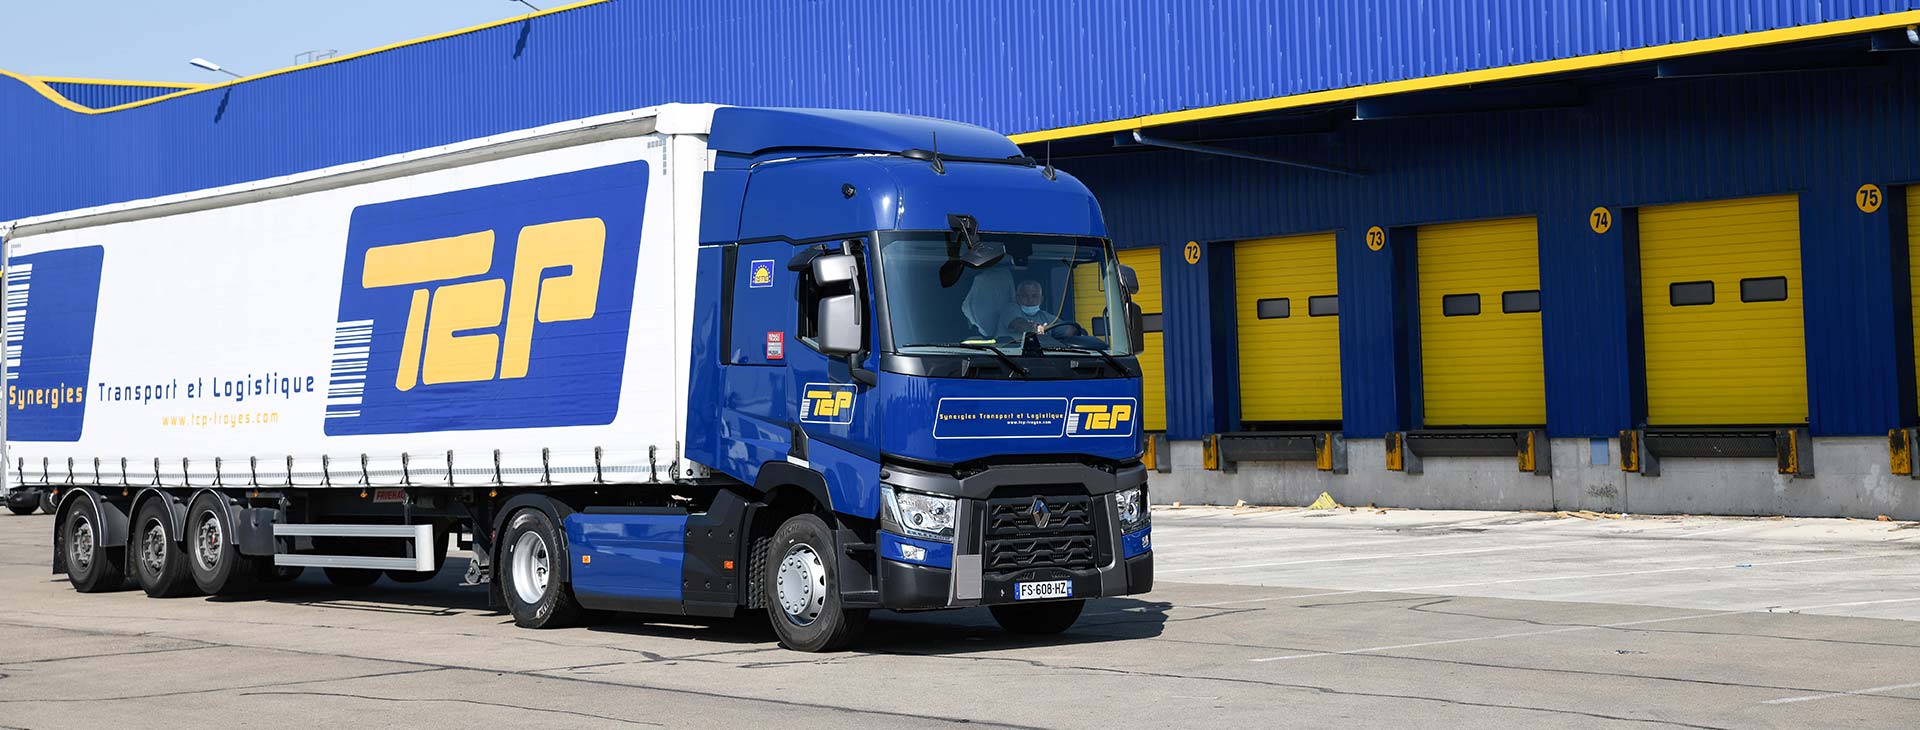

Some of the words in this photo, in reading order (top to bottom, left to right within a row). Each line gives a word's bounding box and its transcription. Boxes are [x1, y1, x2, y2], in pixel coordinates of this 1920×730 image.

[1860, 189, 1879, 207] 75
[1593, 212, 1608, 228] 74
[1369, 231, 1383, 246] 73
[1187, 245, 1198, 260] 72
[9, 382, 83, 410] Synergies
[98, 378, 177, 405] Transport
[187, 377, 203, 398] et
[213, 372, 314, 402] Logistique
[162, 411, 279, 427] www.tcp-troyes.com
[939, 413, 976, 421] Synergies
[1021, 582, 1066, 596] FS-608-HZ
